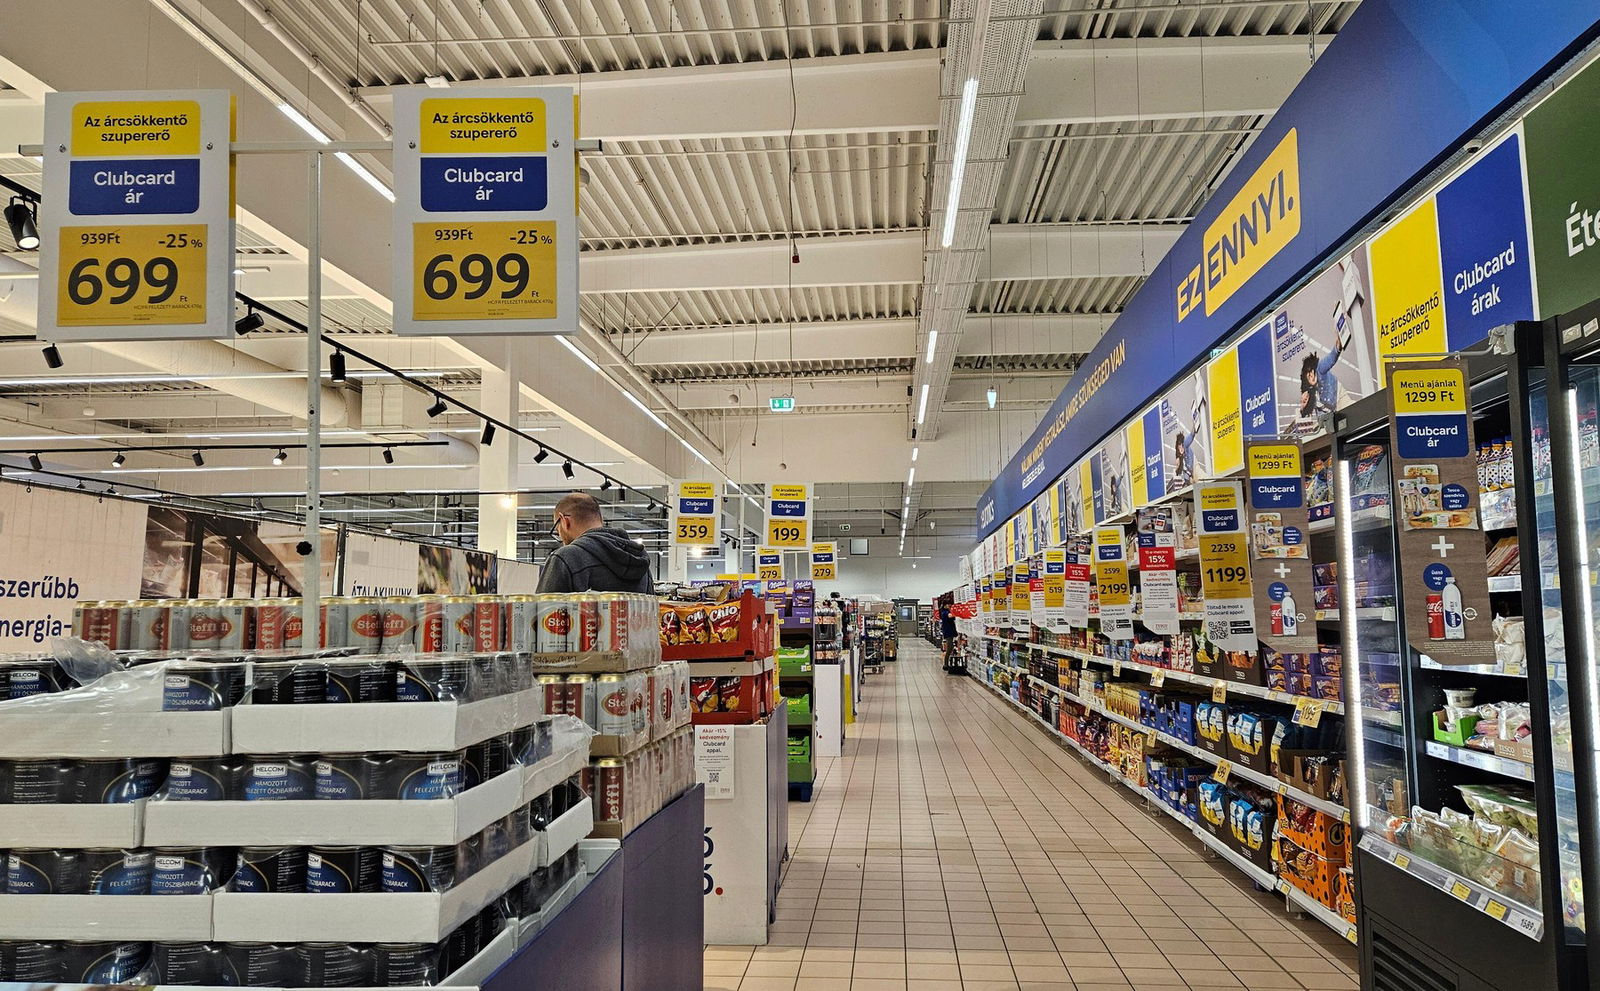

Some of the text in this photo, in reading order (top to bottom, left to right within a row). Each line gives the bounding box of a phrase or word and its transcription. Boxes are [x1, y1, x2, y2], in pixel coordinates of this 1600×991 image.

[84, 114, 188, 128] Az árcsökkentő
[432, 111, 534, 124] Az árcsökkentő
[101, 129, 170, 144] szupererő
[450, 127, 517, 141] szupererő
[94, 170, 175, 186] Clubcard
[444, 168, 524, 183] Clubcard
[125, 189, 144, 204] ár
[475, 186, 494, 201] ár
[81, 232, 203, 249] 939Ft -25 %
[435, 229, 553, 244] 939Ft -25 %
[1177, 169, 1294, 323] EZ ENNYI.
[1454, 241, 1516, 295] Clubcard
[68, 257, 188, 306] 699 Ft
[423, 253, 530, 300] 699
[1471, 283, 1502, 316] árak
[1380, 291, 1439, 338] Az árcsökkentő
[1390, 316, 1430, 349] szupererő
[1110, 338, 1125, 373] VAN
[1400, 379, 1457, 390] Menü ajánlat
[1245, 386, 1271, 413] Clubcard
[1405, 391, 1454, 403] 1299 Ft
[1252, 411, 1266, 428] árak
[1406, 425, 1458, 437] Clubcard
[1427, 437, 1440, 448] ár
[1257, 461, 1293, 470] 1299 Ft
[1258, 485, 1296, 493] Clubcard
[678, 524, 708, 539] 359
[773, 527, 800, 541] 199
[1211, 543, 1236, 553] 2239
[1148, 555, 1166, 563] 15%
[761, 570, 778, 579] 279
[814, 568, 831, 577] 279
[1103, 567, 1120, 575] 2599
[1206, 566, 1247, 583] 1199
[0, 576, 79, 599] szerűbb
[768, 580, 786, 589] Milka
[794, 580, 812, 589] Milka
[1100, 583, 1127, 595] 2199
[709, 606, 738, 622] Chio
[0, 614, 72, 643] nergia-
[430, 762, 457, 772] HELCOM
[1520, 917, 1535, 930] 1589
